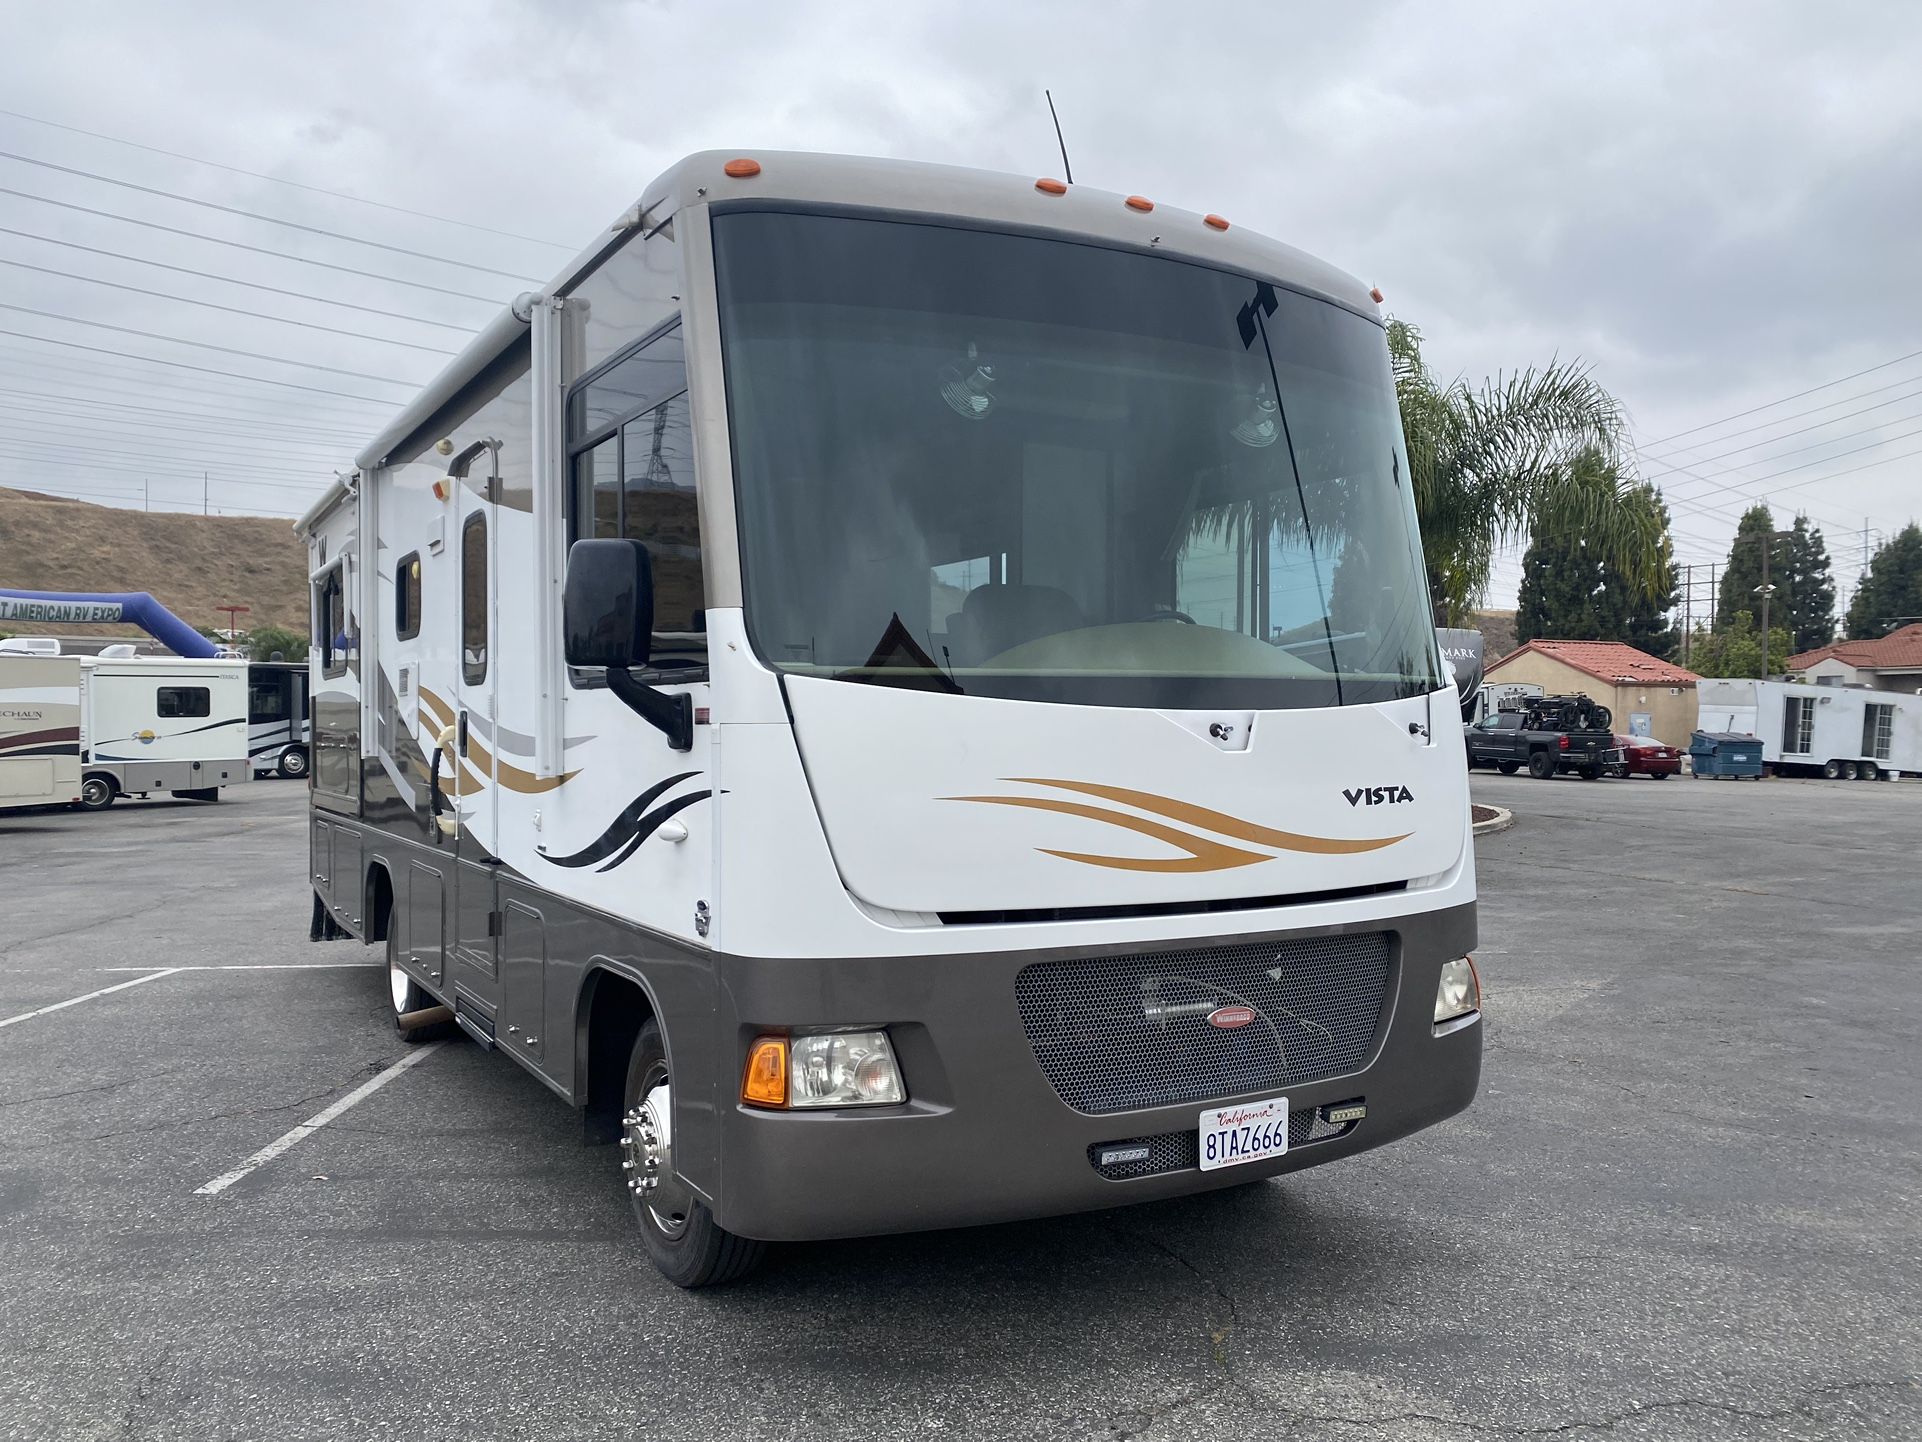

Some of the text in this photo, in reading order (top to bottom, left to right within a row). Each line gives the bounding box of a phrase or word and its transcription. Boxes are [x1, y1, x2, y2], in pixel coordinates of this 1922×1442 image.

[10, 603, 72, 620] AMERICAN
[74, 606, 90, 620] RV
[91, 607, 121, 620] EXPO
[1342, 785, 1415, 807] VISTA
[1219, 1109, 1273, 1127] California
[1206, 1120, 1283, 1161] 8TAZ666
[1222, 1151, 1268, 1164] dmv.ca.gov
